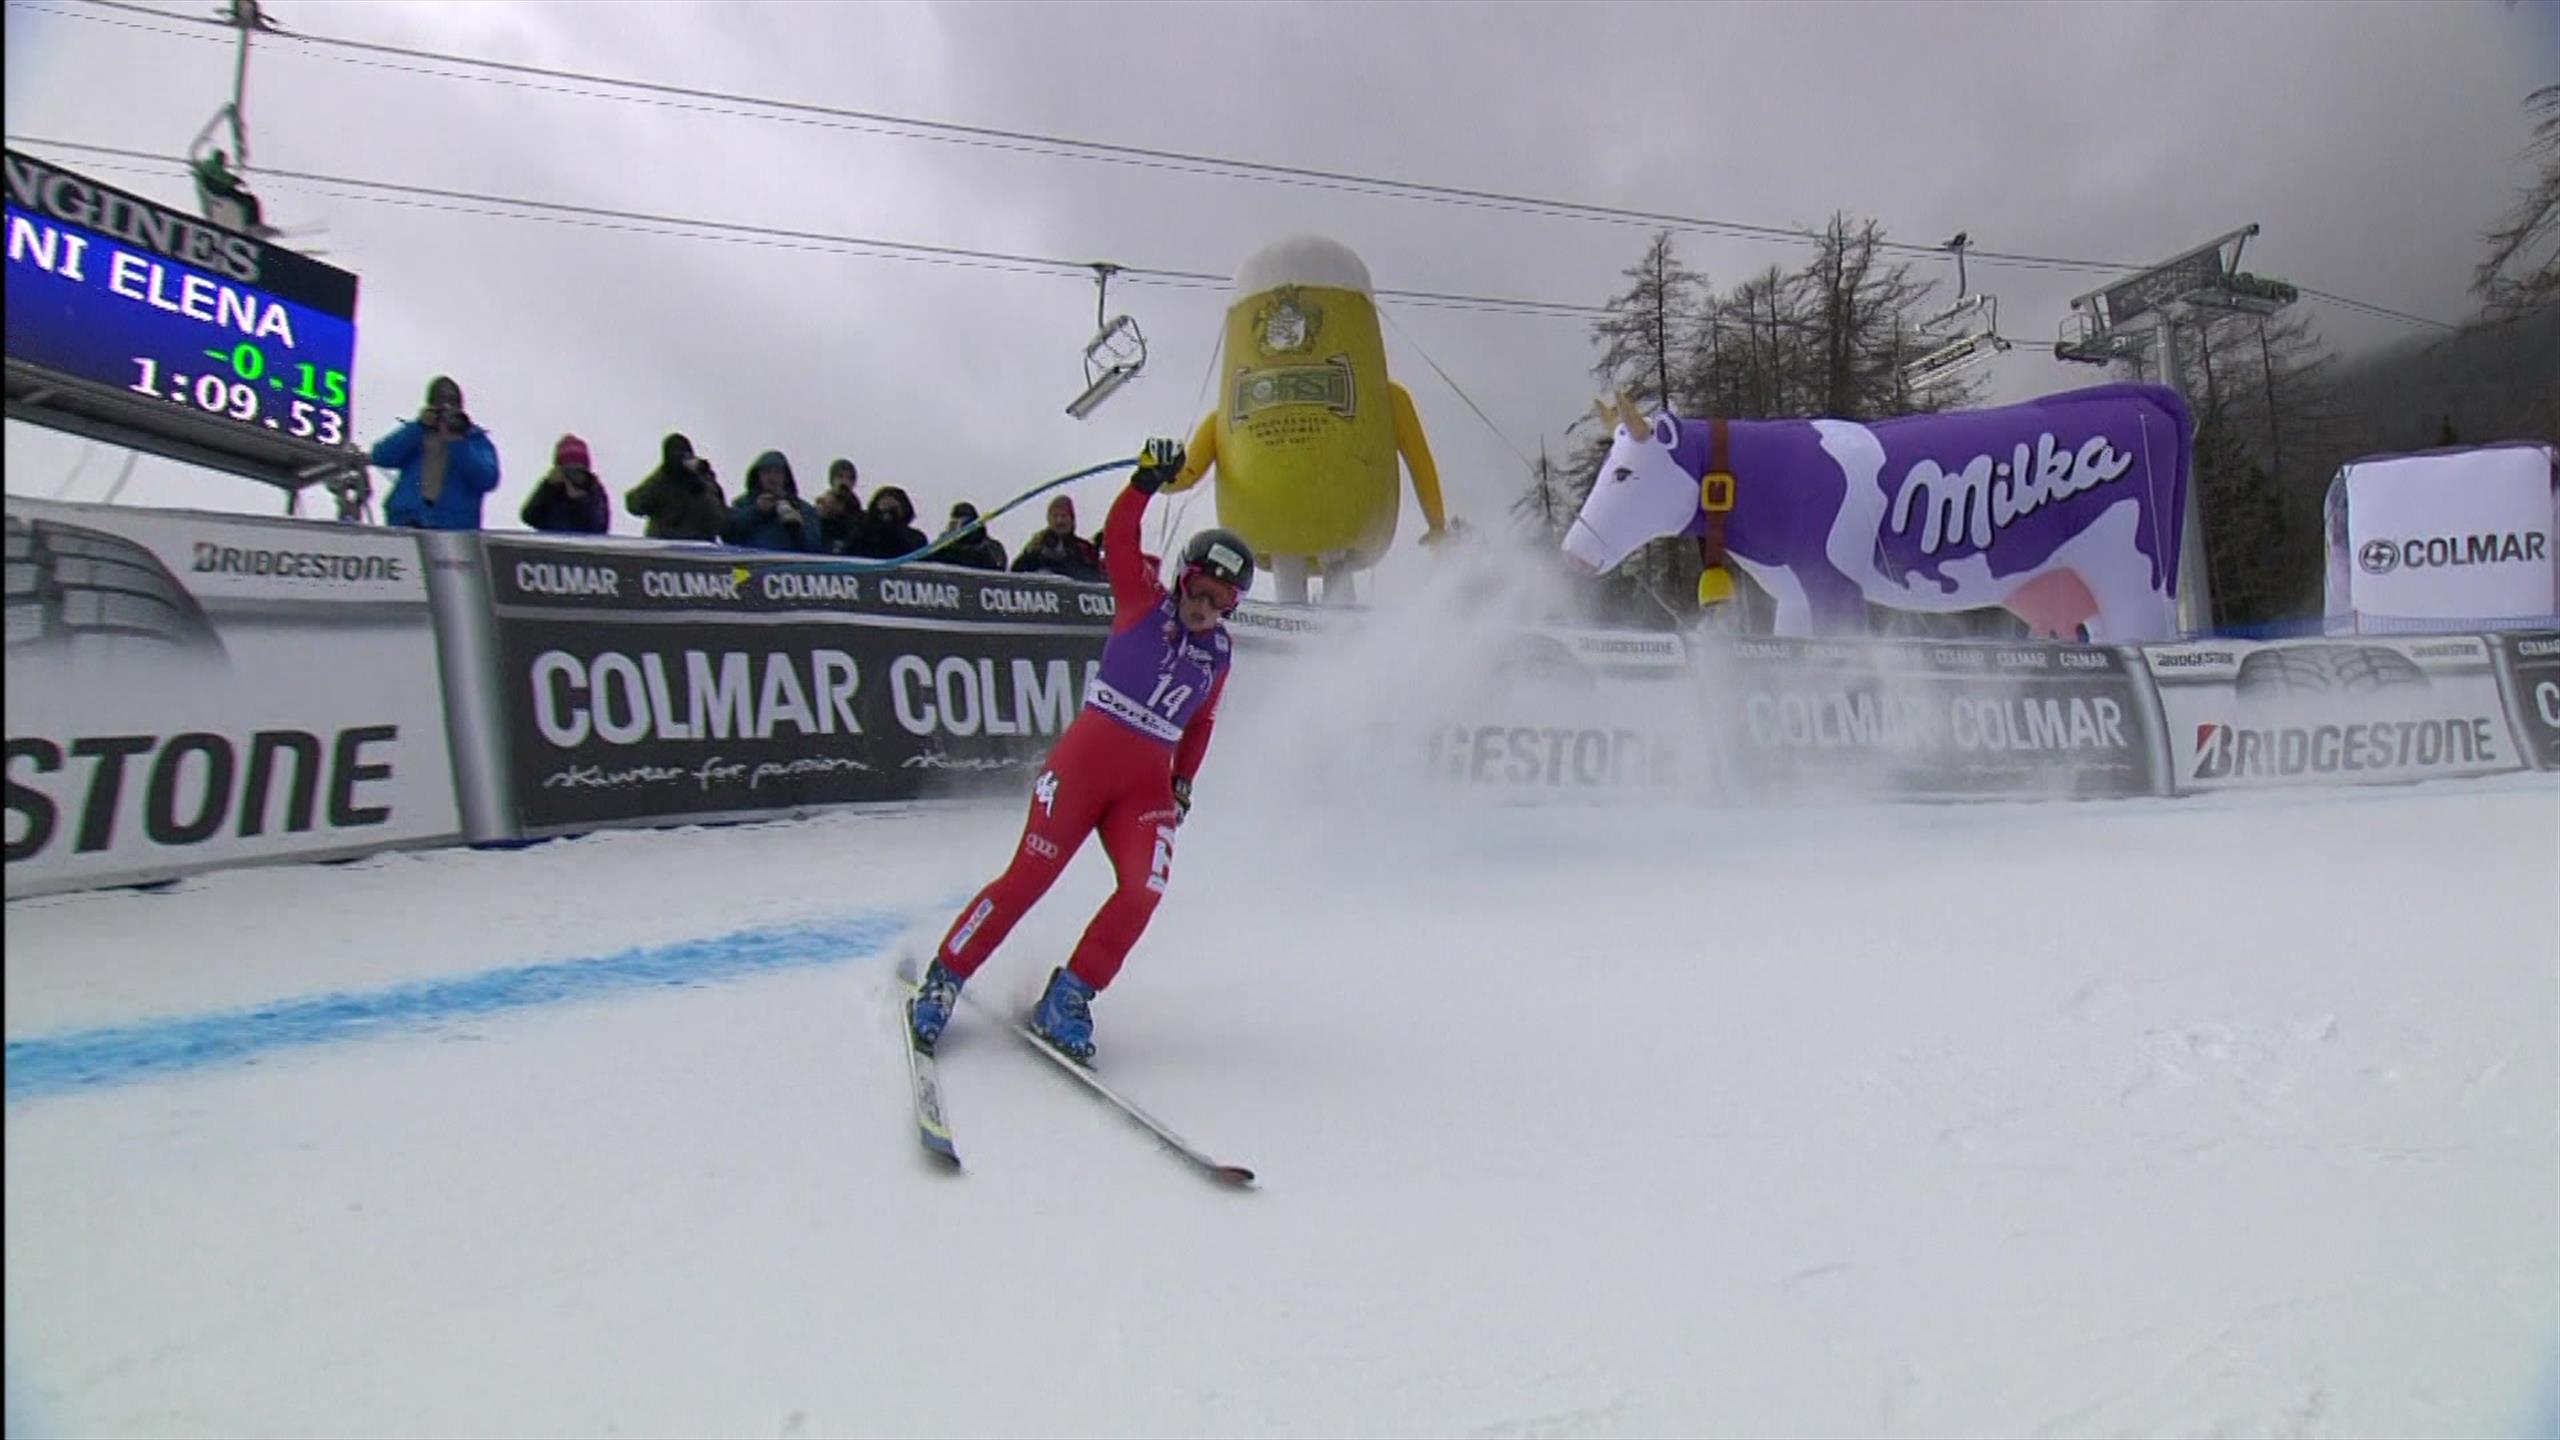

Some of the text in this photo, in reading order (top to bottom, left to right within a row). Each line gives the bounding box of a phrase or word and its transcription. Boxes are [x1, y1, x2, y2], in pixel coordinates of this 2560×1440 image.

[109, 250, 294, 348] ELENA
[129, 358, 344, 445] 1:09.53
[204, 344, 348, 407] -0.15
[1892, 432, 2132, 555] Milka
[193, 541, 404, 581] BRIDGESTONE
[2403, 531, 2546, 568] COLMAR
[516, 561, 619, 597] COLMAR
[642, 569, 740, 599] COLMAR
[763, 573, 859, 600] COLMAR
[880, 579, 960, 609] COLMAR
[980, 587, 1060, 613] COLMAR
[531, 650, 863, 748] COLMAR
[1146, 672, 1193, 720] 14
[1951, 696, 2127, 750] COLMAR
[692, 756, 747, 792] for
[2193, 718, 2496, 779] BRIDGESTONE
[5, 724, 399, 864] STONE
